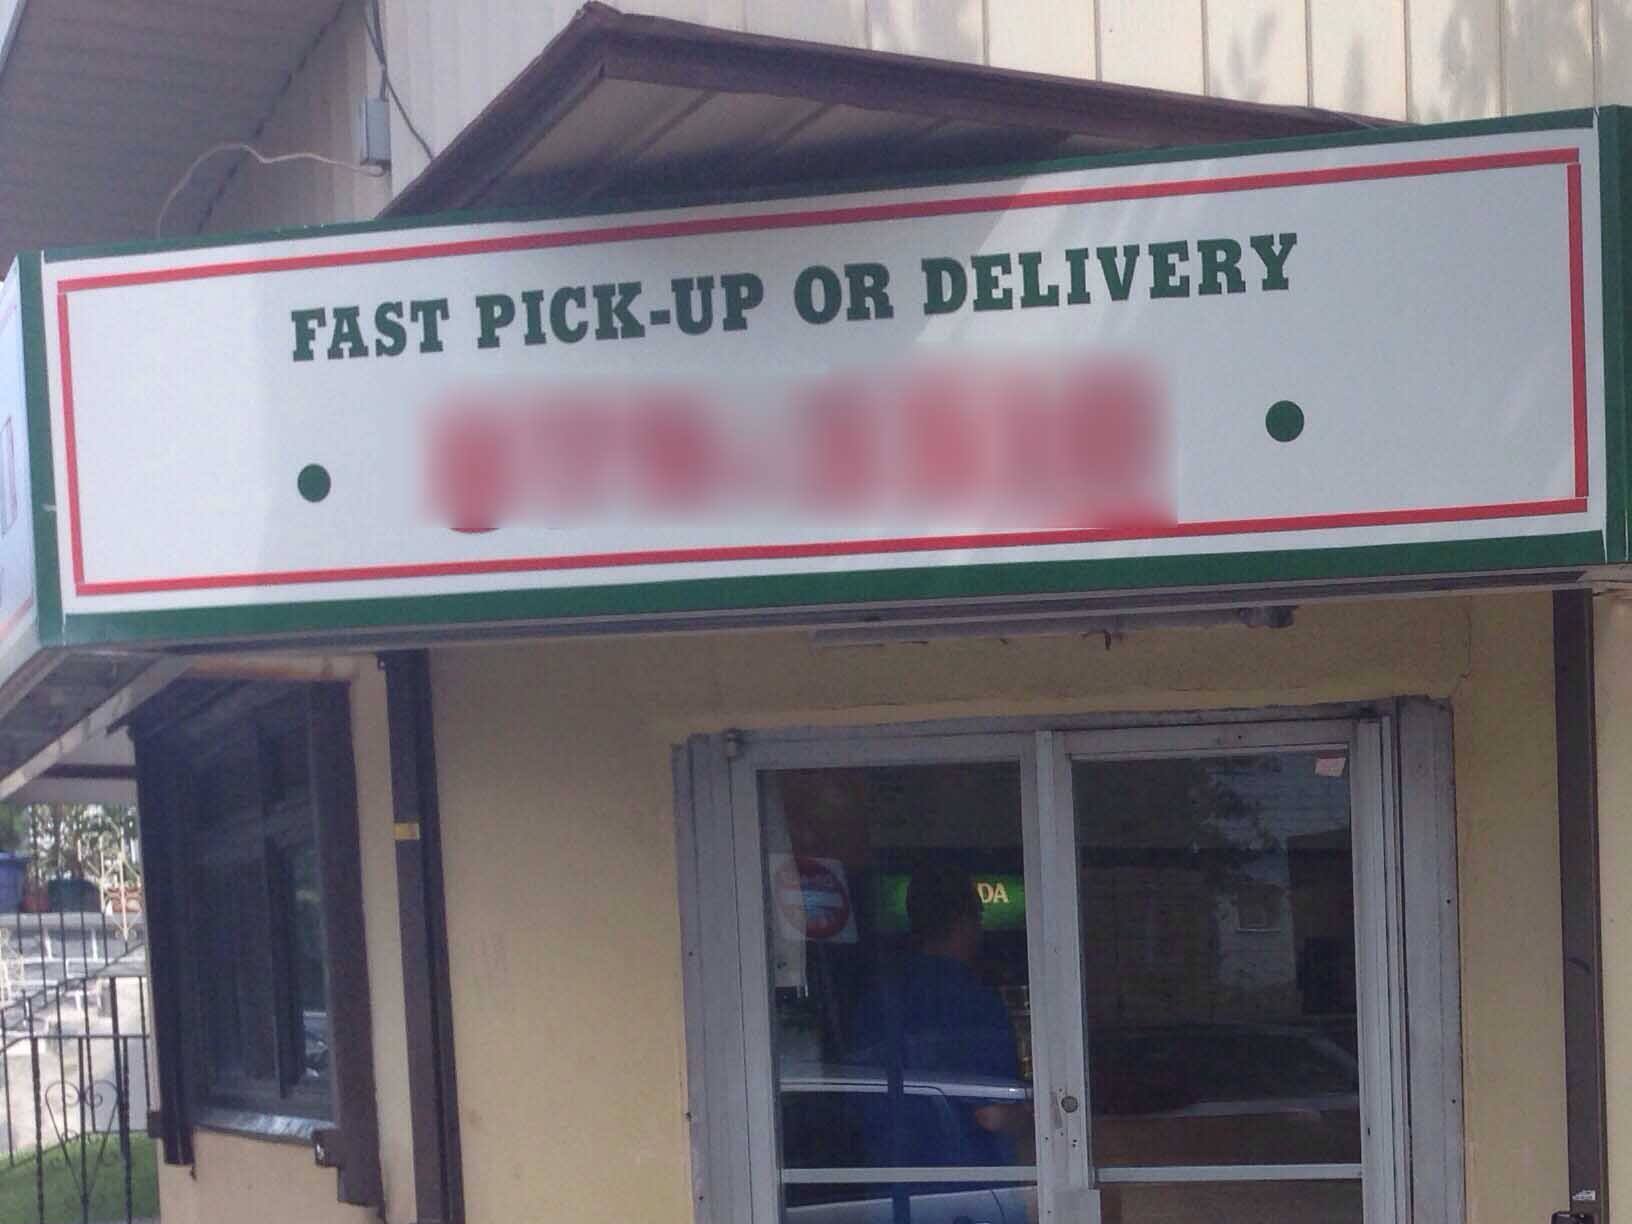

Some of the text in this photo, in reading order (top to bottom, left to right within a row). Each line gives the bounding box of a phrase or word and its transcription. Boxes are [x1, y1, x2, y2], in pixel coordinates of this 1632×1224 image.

[291, 233, 1299, 361] FAST PICK-UP OR DELIVERY
